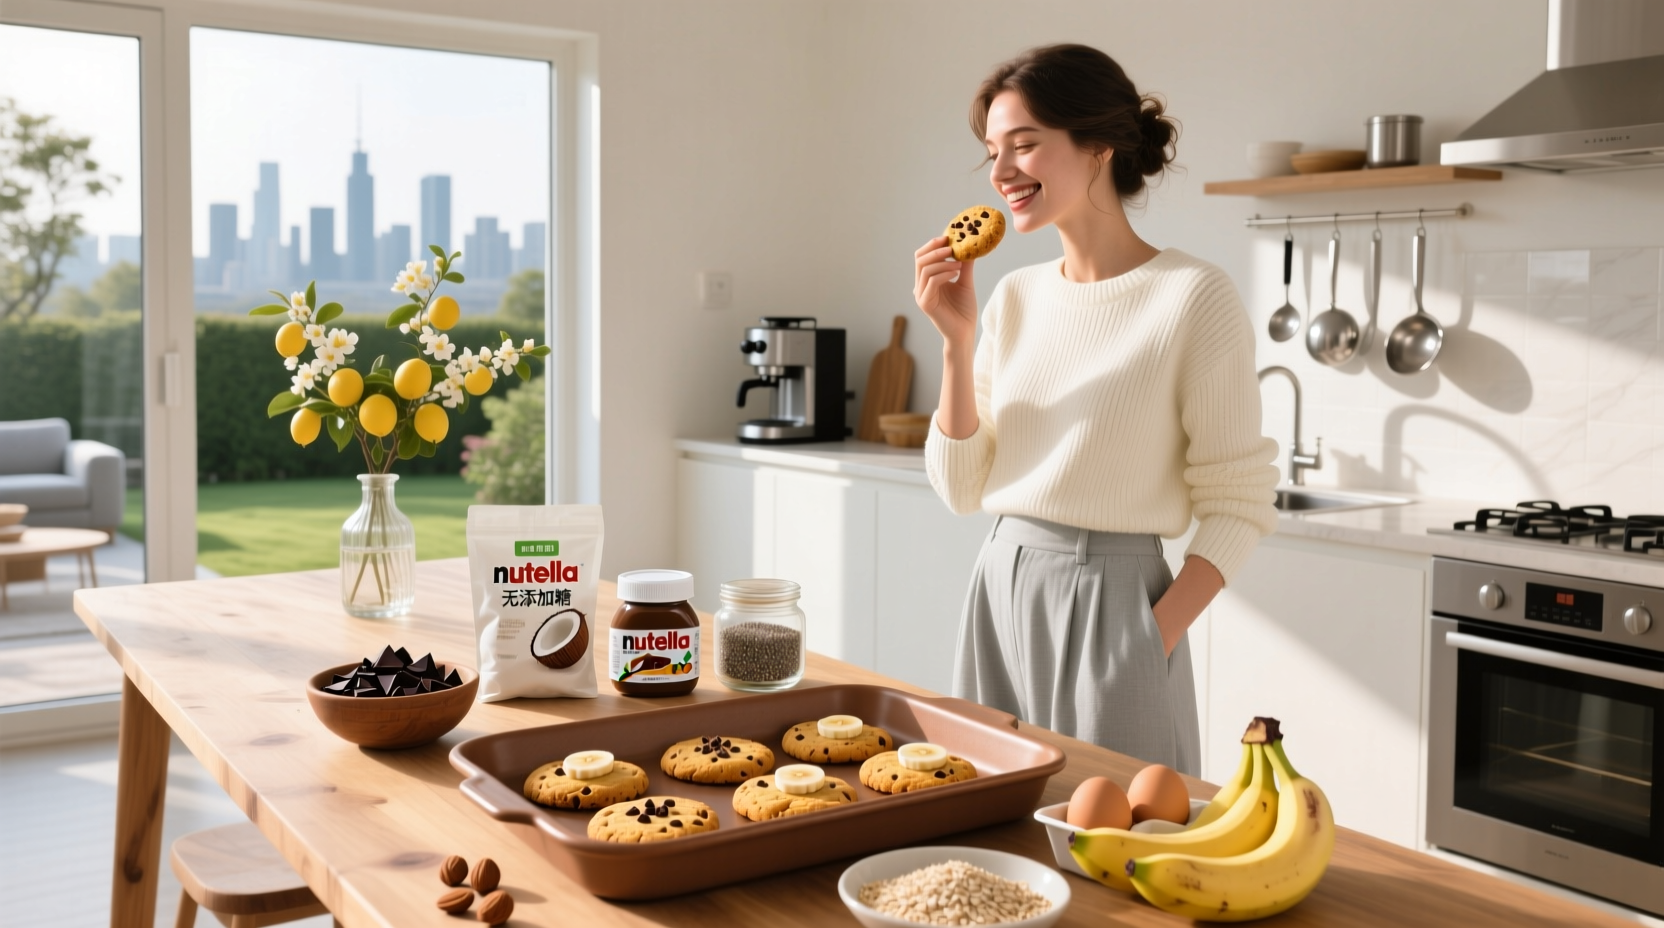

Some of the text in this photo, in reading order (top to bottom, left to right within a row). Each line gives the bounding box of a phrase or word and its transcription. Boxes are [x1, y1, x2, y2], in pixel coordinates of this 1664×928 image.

[493, 560, 579, 584] nutella
[501, 588, 572, 607] 无添加糖
[622, 631, 690, 651] nutella
